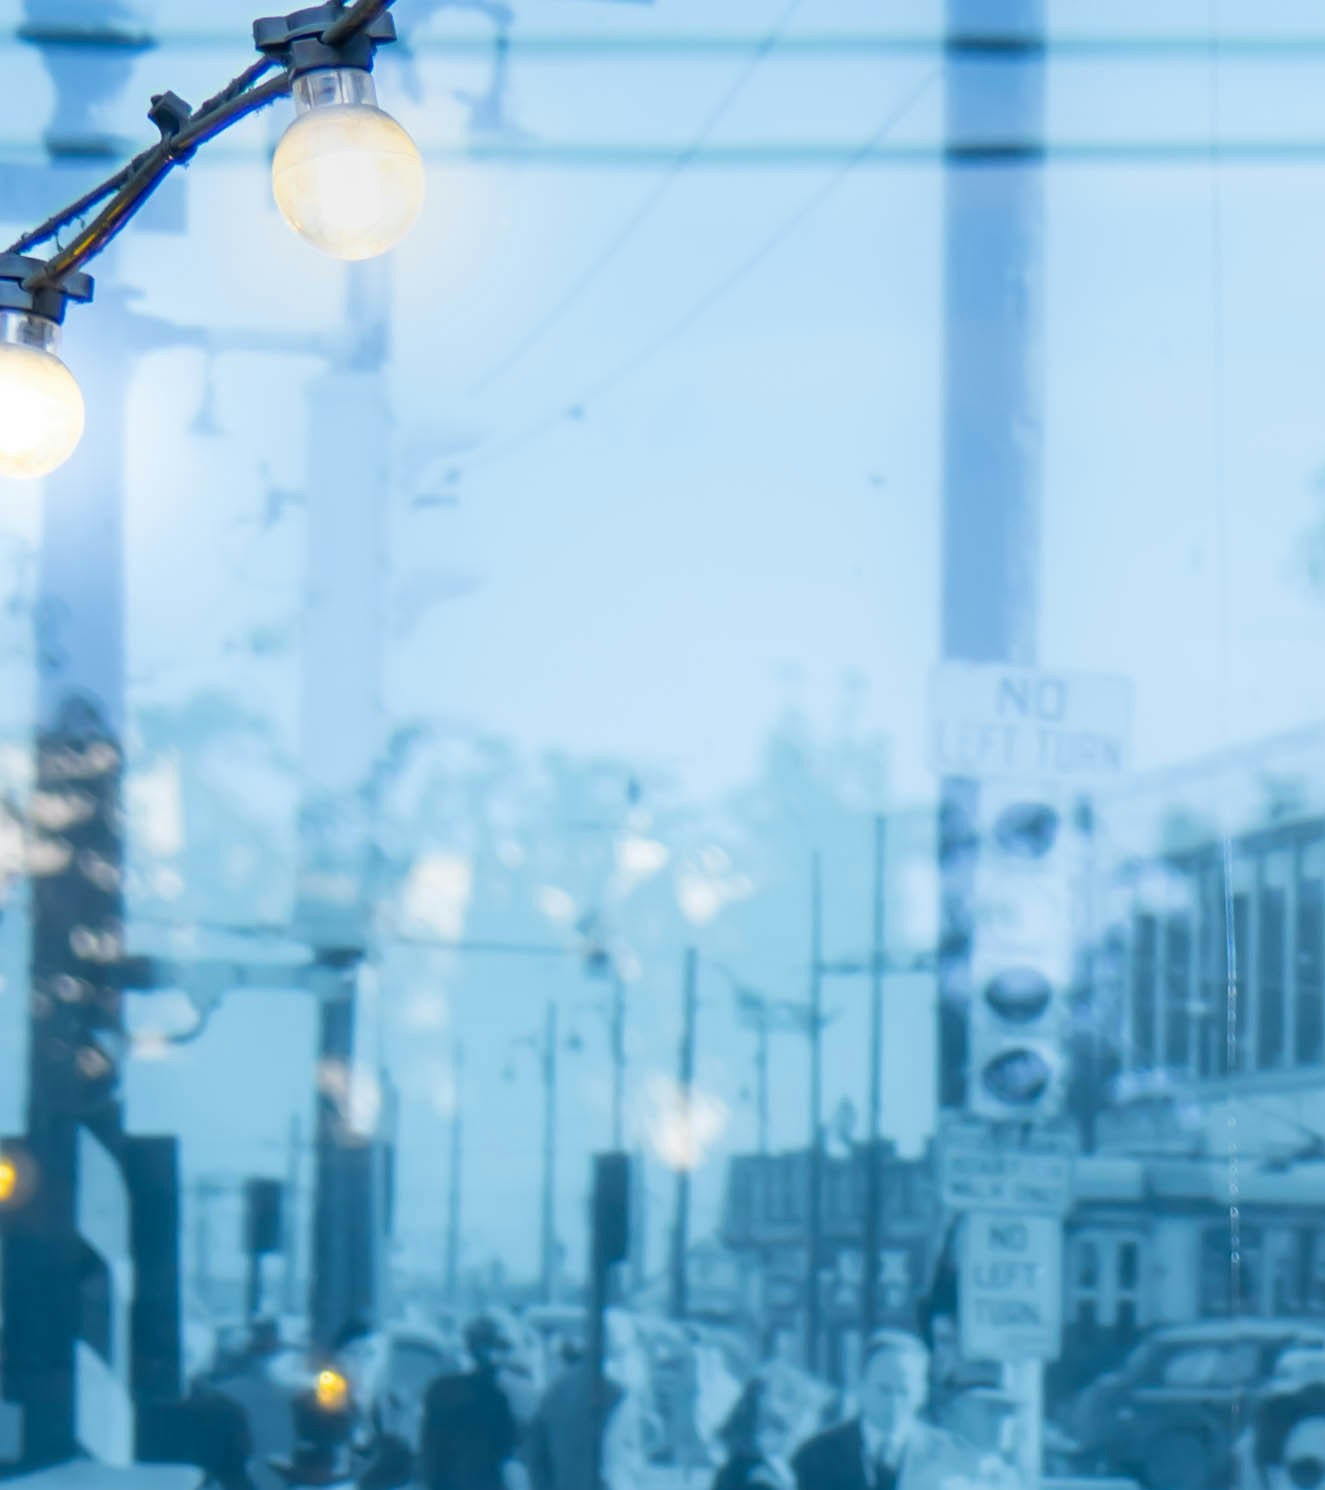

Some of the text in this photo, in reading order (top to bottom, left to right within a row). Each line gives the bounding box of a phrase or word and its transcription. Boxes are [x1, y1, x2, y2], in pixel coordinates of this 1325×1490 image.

[995, 674, 1067, 722] NO
[934, 719, 1021, 772] LEFT
[988, 1222, 1028, 1252] NO
[972, 1262, 1039, 1290] LEFT
[973, 1299, 1042, 1327] TURN
